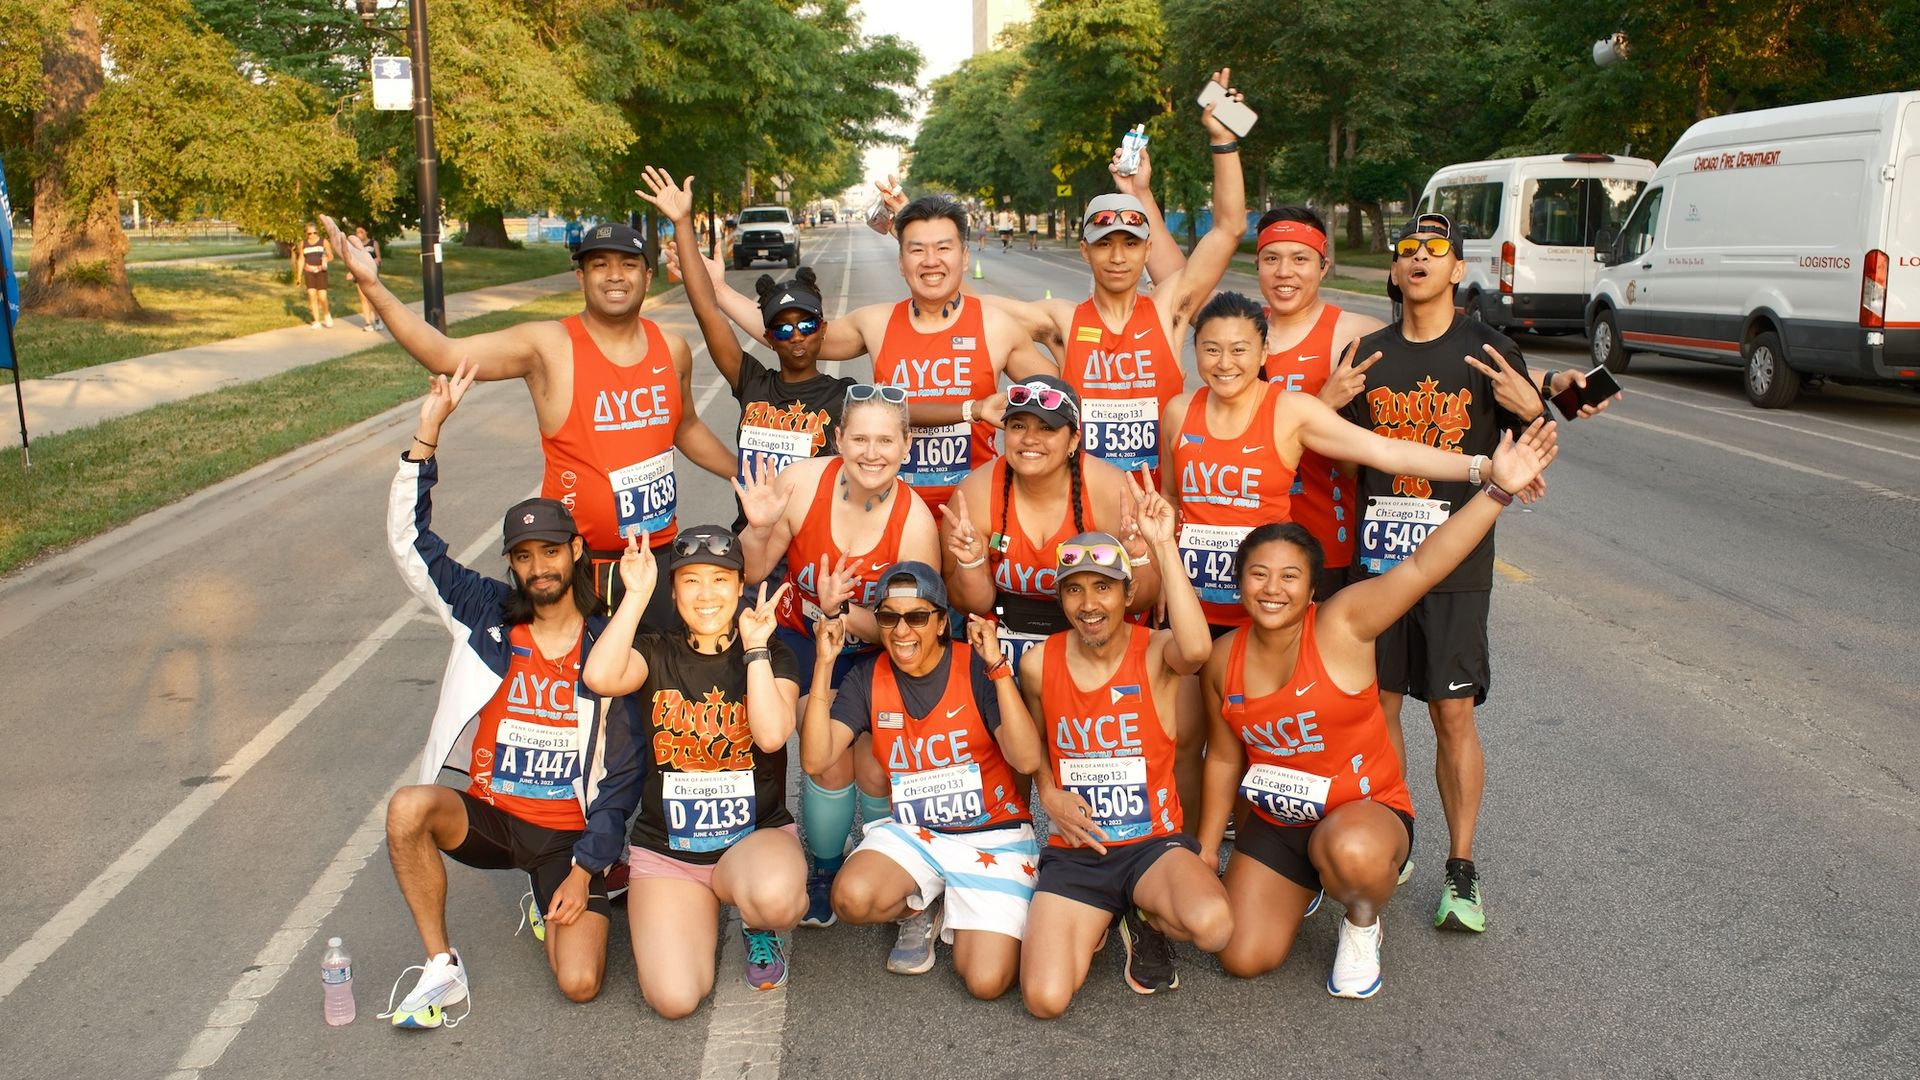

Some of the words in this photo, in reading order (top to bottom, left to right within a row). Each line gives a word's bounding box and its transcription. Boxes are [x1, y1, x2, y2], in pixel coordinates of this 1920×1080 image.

[1720, 152, 1735, 170] FIRE
[1736, 150, 1781, 168] DEPARTMENT
[1799, 256, 1850, 269] LOGISTICS
[1091, 410, 1129, 421] Chicago
[1130, 410, 1143, 419] 13.1
[1366, 375, 1472, 432] FAMILY
[747, 437, 780, 451] Chicago
[781, 441, 795, 452] 13.1
[1085, 423, 1099, 450] B
[1105, 421, 1156, 451] 5386
[916, 437, 968, 466] 1602
[621, 470, 656, 486] Chicago
[618, 491, 635, 519] B
[638, 474, 675, 514] 7638
[1375, 508, 1413, 521] Chicago
[1415, 510, 1430, 521] 13.1
[1189, 536, 1228, 549] Chicago
[1363, 521, 1379, 550] C
[995, 558, 1058, 595] AYC
[1183, 550, 1198, 580] C
[1204, 552, 1238, 582] 42
[652, 685, 753, 743] FAMILY
[508, 732, 552, 748] Chicago
[553, 738, 569, 747] 13.1
[652, 730, 756, 772] STYLE
[500, 746, 517, 774] A
[522, 749, 578, 779] 1447
[903, 783, 947, 798] Chicago
[947, 778, 965, 790] 13.1
[927, 772, 955, 781] AMERICA
[1070, 771, 1110, 783] Chicago
[1111, 770, 1127, 780] 13.1
[1252, 775, 1292, 793] Chicago
[1293, 783, 1309, 796] 13.1
[1277, 772, 1304, 781] AMERICA
[674, 785, 718, 797] Chicago
[719, 784, 736, 794] 13.1
[1087, 785, 1144, 819] 1505
[669, 800, 686, 830] D
[694, 797, 751, 830] 2133
[898, 802, 917, 826] D
[923, 791, 982, 824] 4549
[1264, 794, 1320, 821] 1359
